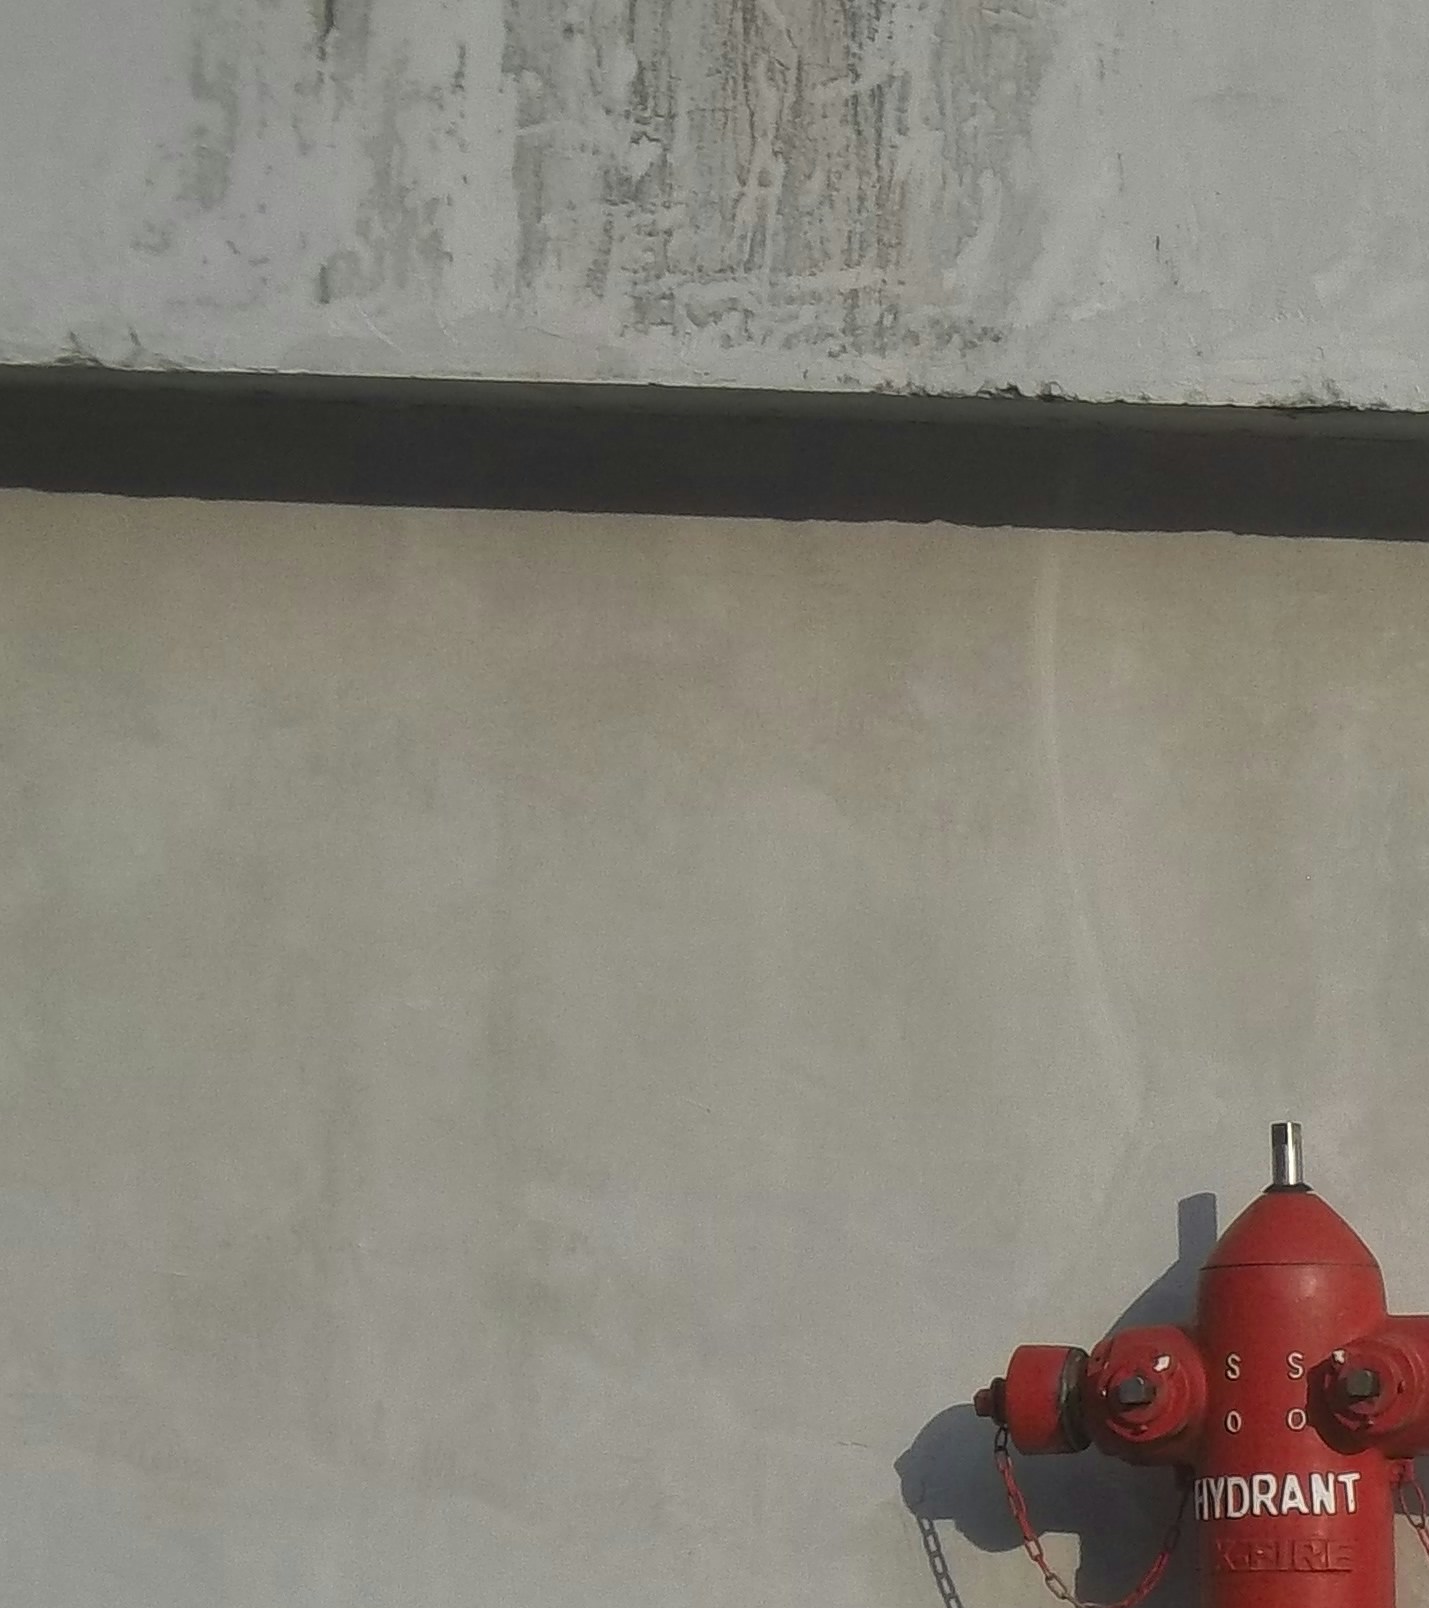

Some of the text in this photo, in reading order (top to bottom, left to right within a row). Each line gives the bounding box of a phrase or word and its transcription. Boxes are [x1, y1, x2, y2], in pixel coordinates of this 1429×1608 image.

[1226, 1352, 1304, 1379] S S
[1194, 1472, 1361, 1521] HYDRANT
